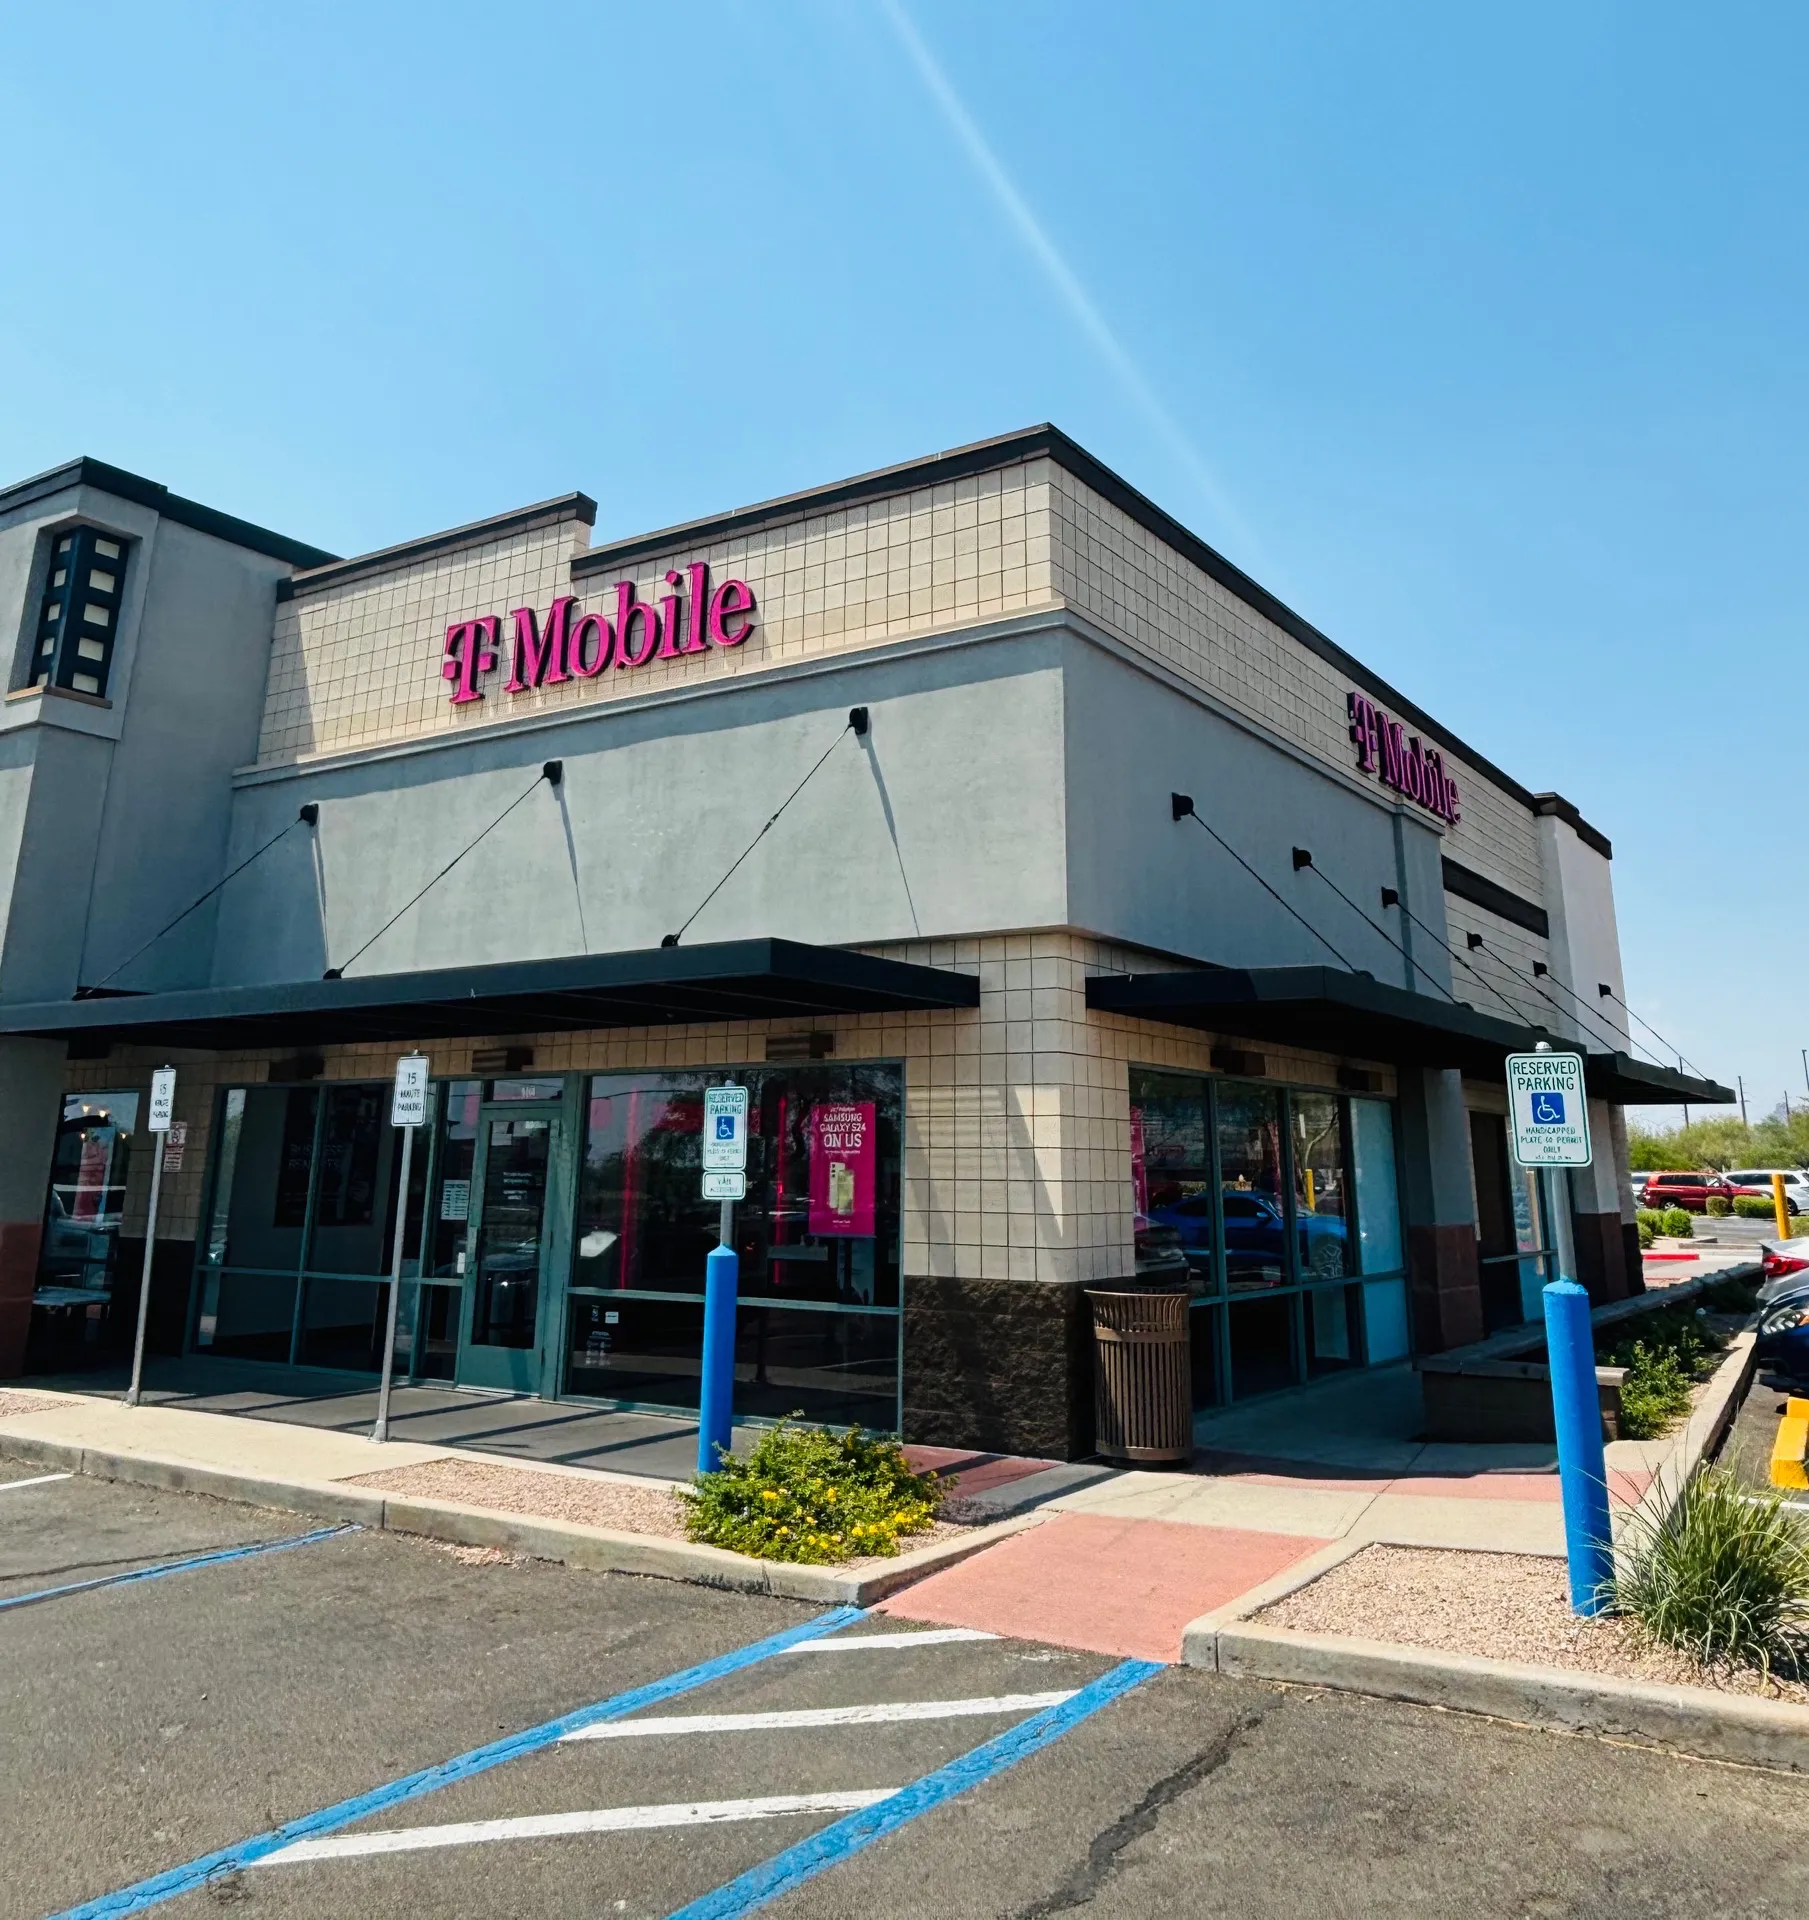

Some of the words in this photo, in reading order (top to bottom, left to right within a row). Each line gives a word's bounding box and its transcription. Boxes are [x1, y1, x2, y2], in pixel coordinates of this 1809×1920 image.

[504, 561, 756, 693] Mobile
[1376, 711, 1461, 825] Mobile
[1513, 1061, 1576, 1075] RESERVED
[407, 1072, 417, 1085] 15
[1517, 1077, 1575, 1091] PARKING
[708, 1092, 744, 1103] RESERVED
[709, 1104, 742, 1115] PARKING
[823, 1113, 863, 1122] SAMSUNG
[819, 1123, 850, 1133] GALAXY
[851, 1122, 867, 1132] S24
[1525, 1126, 1576, 1135] HANDICAPPED
[823, 1133, 842, 1148] ON
[845, 1132, 862, 1148] US
